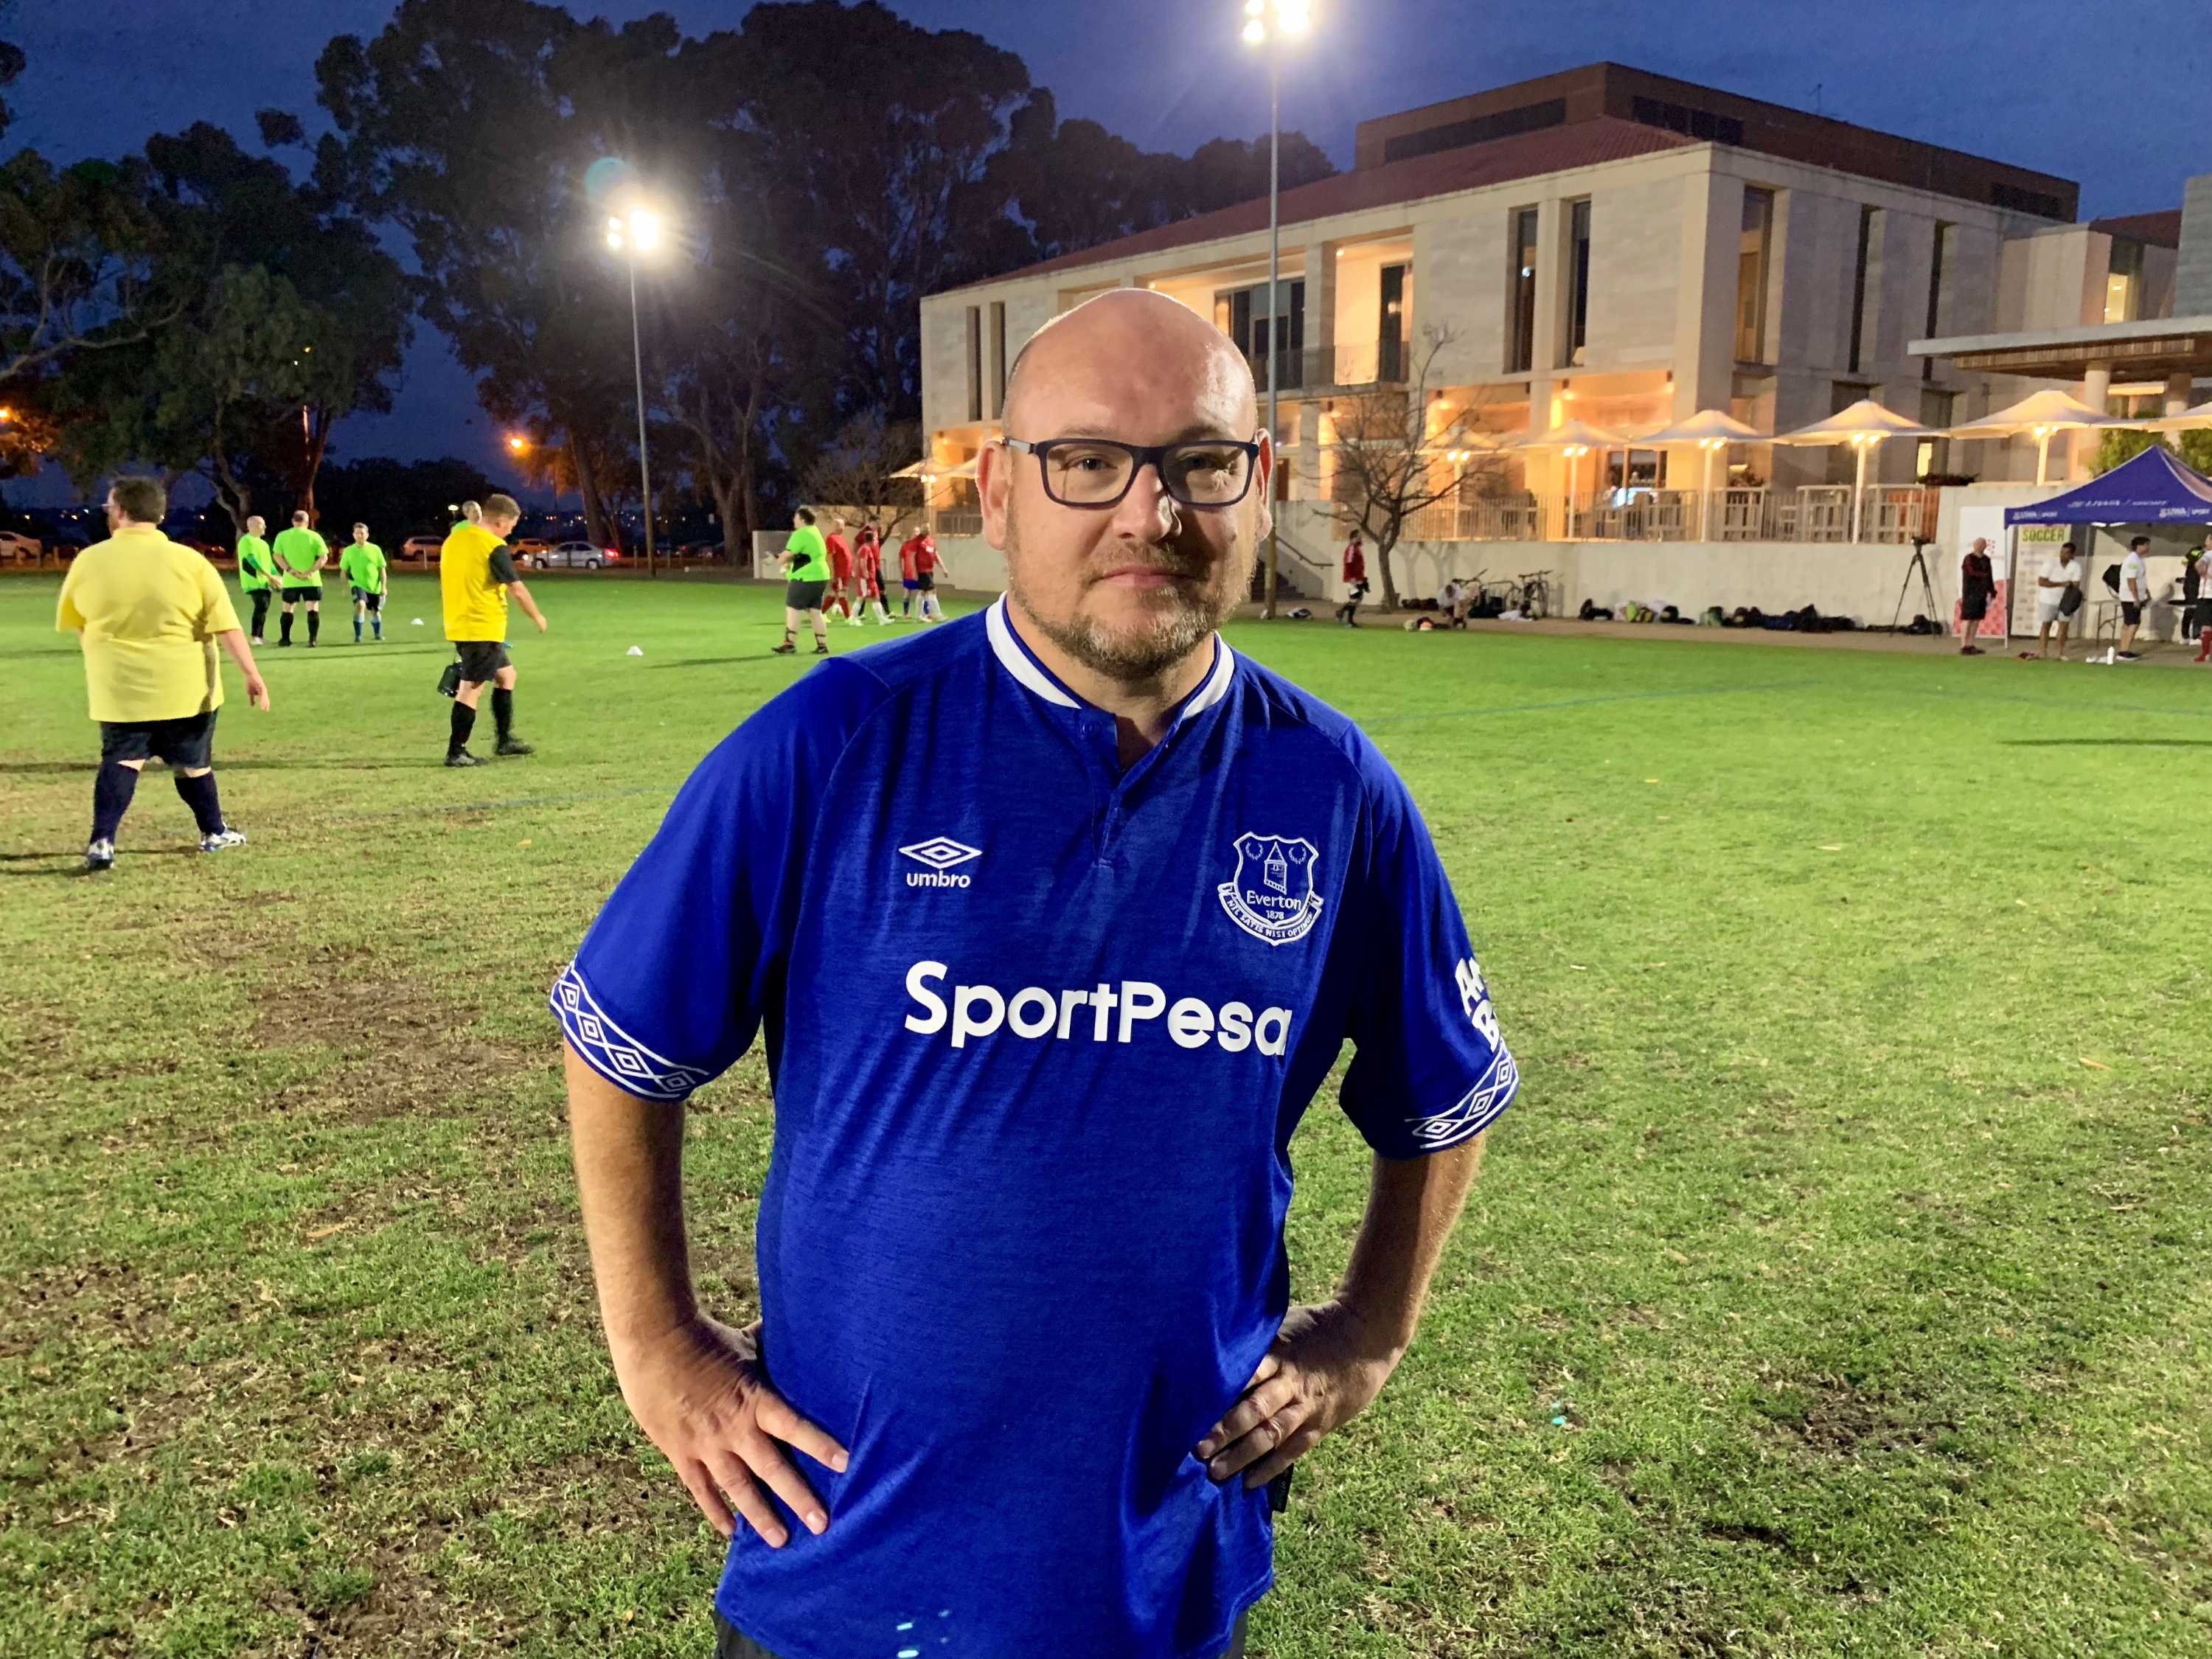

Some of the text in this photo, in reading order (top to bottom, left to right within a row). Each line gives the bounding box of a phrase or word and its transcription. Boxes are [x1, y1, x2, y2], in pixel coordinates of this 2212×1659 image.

[2023, 529, 2065, 542] SOCCER
[906, 870, 971, 888] umbro
[1246, 890, 1302, 911] Everton
[1226, 900, 1241, 916] NIL
[1240, 914, 1264, 933] SATIS
[1265, 929, 1285, 938] NISI
[1265, 910, 1284, 919] 1878
[904, 960, 1293, 1057] SportPesa
